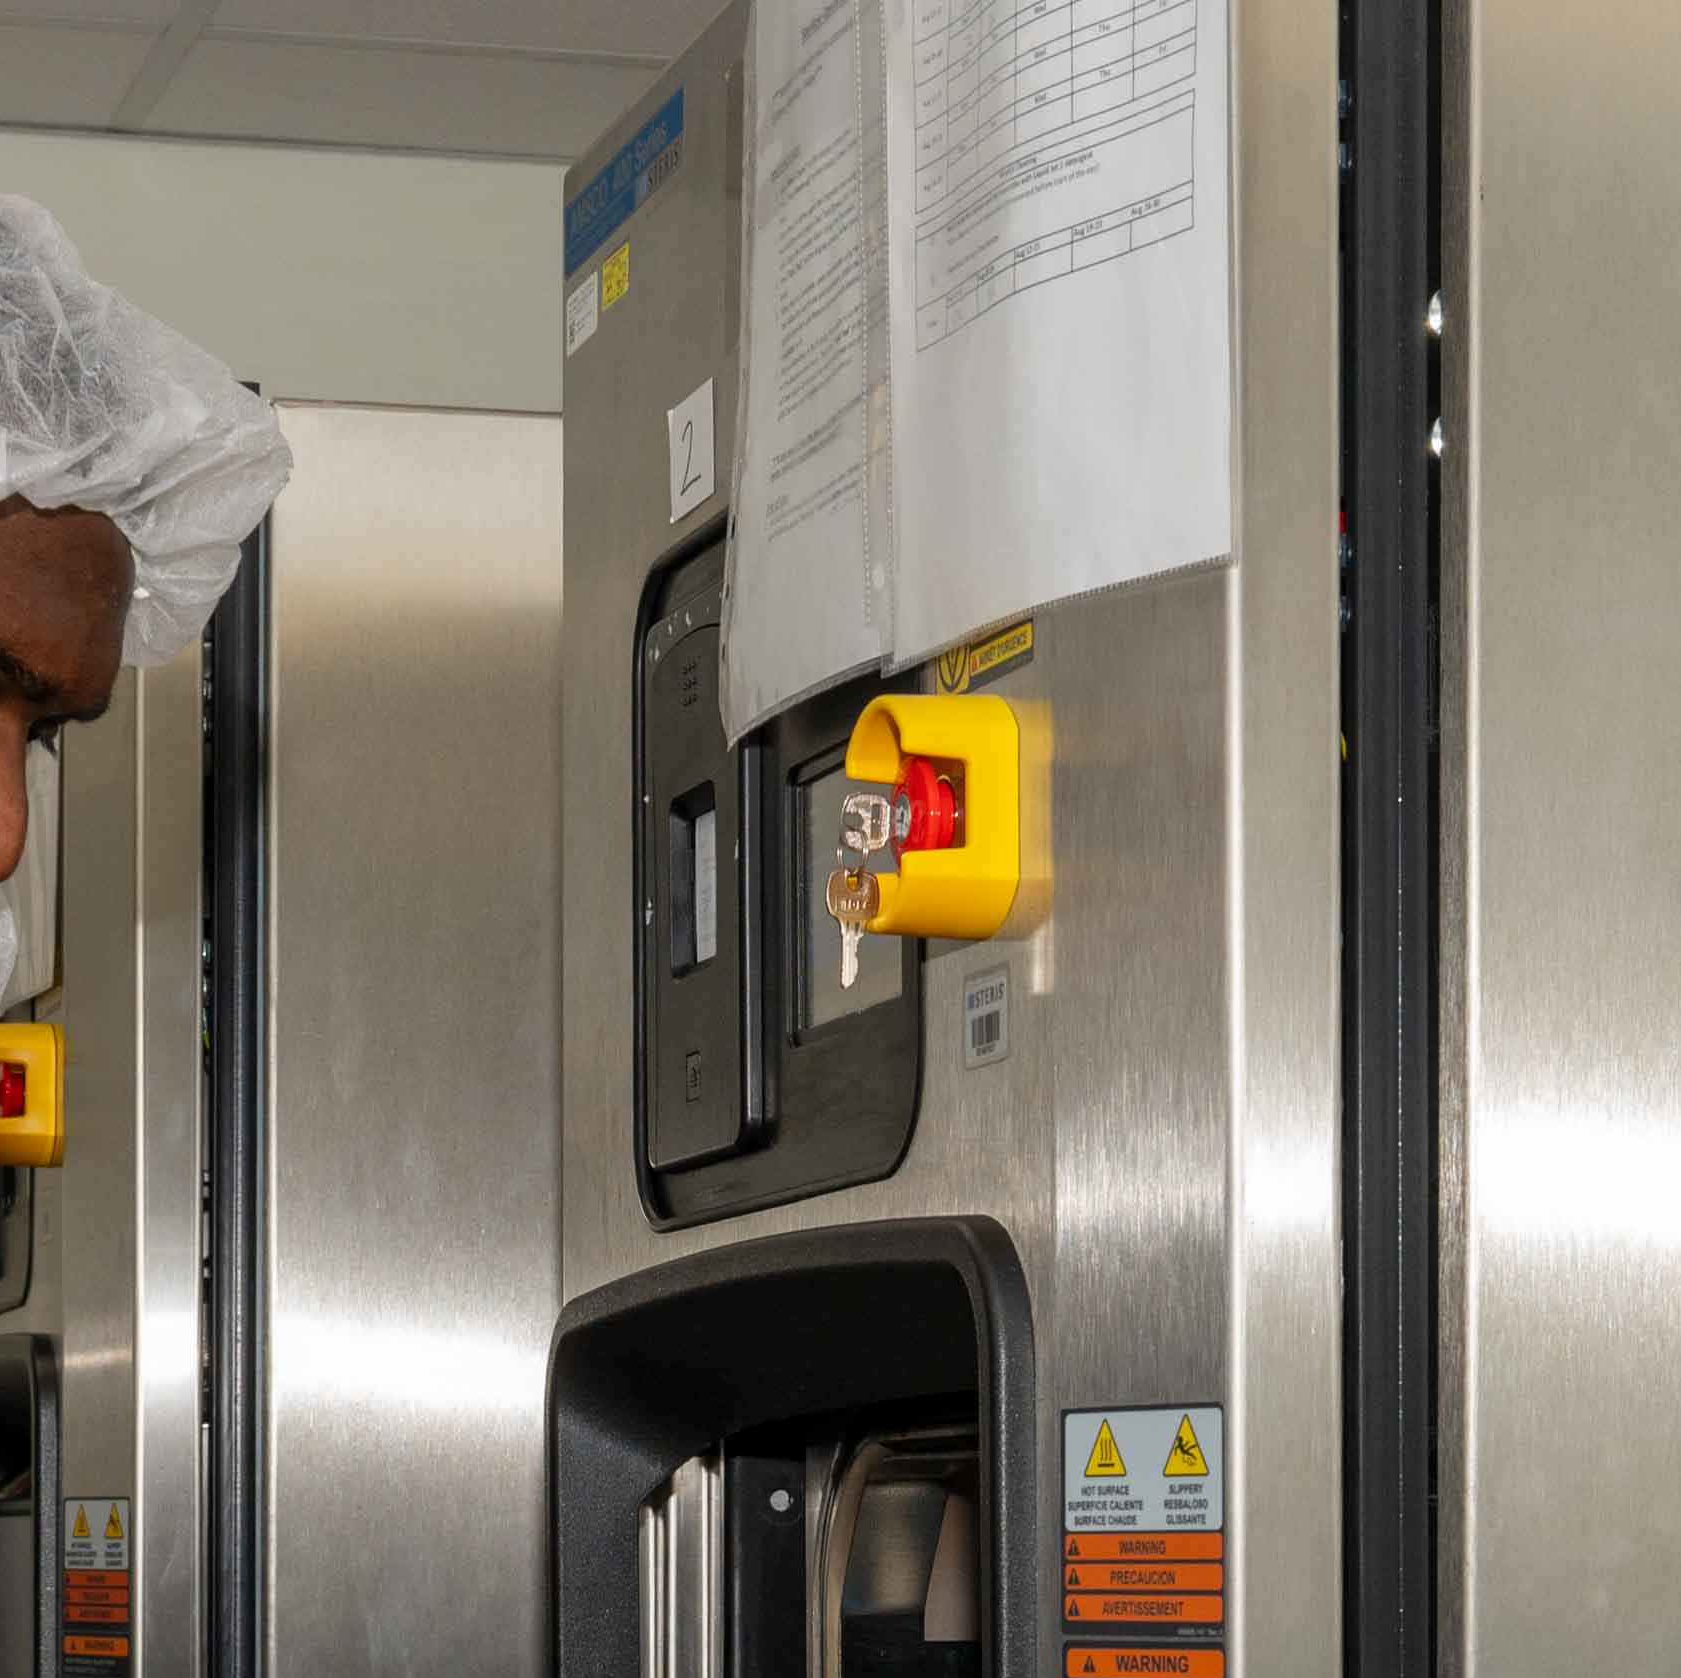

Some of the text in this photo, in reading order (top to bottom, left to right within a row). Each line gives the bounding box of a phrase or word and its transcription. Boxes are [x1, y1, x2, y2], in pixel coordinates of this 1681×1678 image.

[679, 419, 702, 497] 2
[974, 983, 1005, 1009] STERIS
[1081, 1485, 1129, 1496] HOT SURFACE
[1169, 1484, 1203, 1494] SLIPPERY
[1069, 1500, 1143, 1511] SUPERFICIE CALIENTE
[1075, 1515, 1137, 1526] SURFACE CHAUDE
[1166, 1515, 1206, 1525] GLISSANTE
[1119, 1541, 1166, 1555] WARNING
[1110, 1571, 1176, 1585] PRECAUCION
[1103, 1602, 1183, 1616] AVERTISSEMENT
[1117, 1656, 1189, 1673] WARNING
